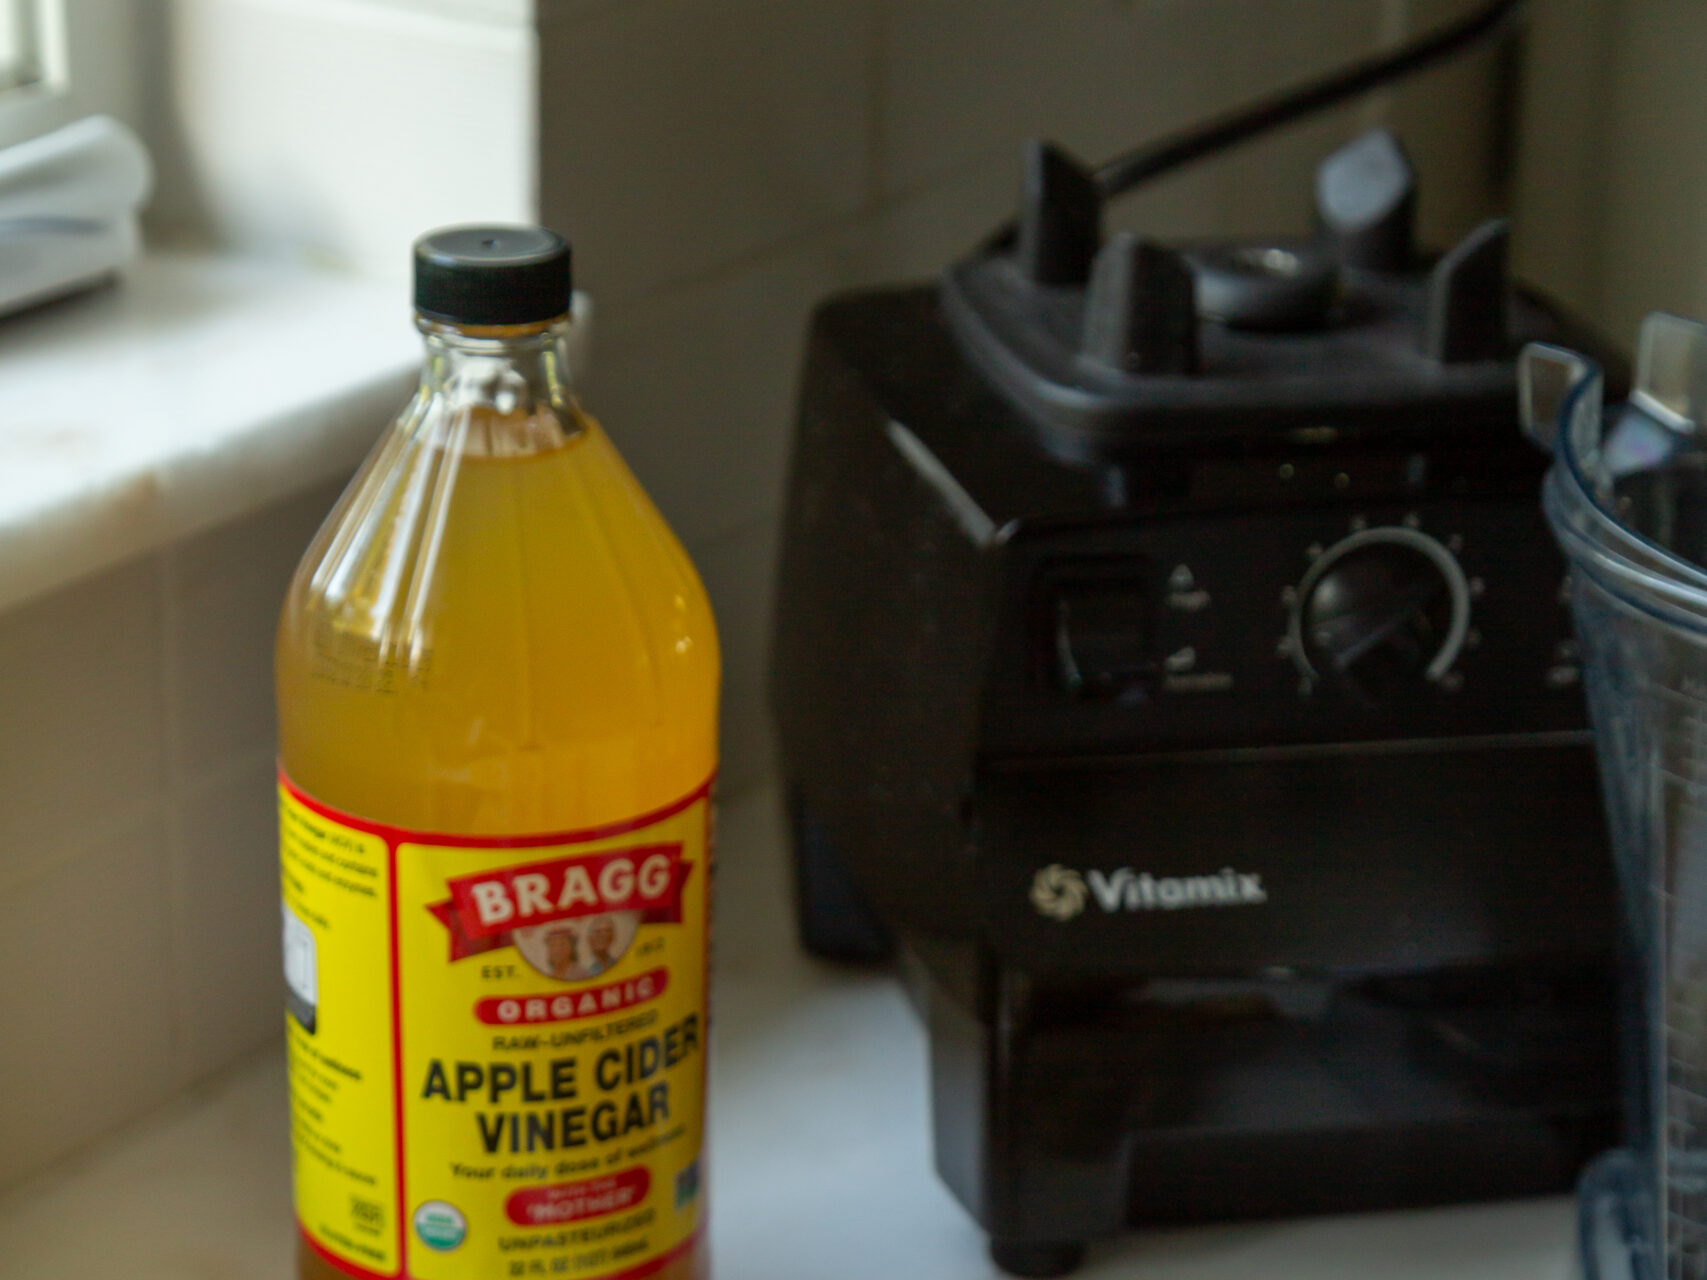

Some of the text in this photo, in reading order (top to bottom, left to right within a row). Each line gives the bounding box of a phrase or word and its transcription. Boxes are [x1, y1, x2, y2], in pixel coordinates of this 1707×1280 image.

[471, 853, 671, 926] BRAGG
[1086, 867, 1268, 912] Vitamix
[496, 976, 654, 1023] ORGANIC
[421, 1056, 578, 1104] APPLE
[594, 1012, 699, 1091] CIDER
[477, 1081, 670, 1154] VINEGAR
[450, 1162, 495, 1180] Your
[501, 1161, 548, 1181] daily
[554, 1158, 600, 1176] dose
